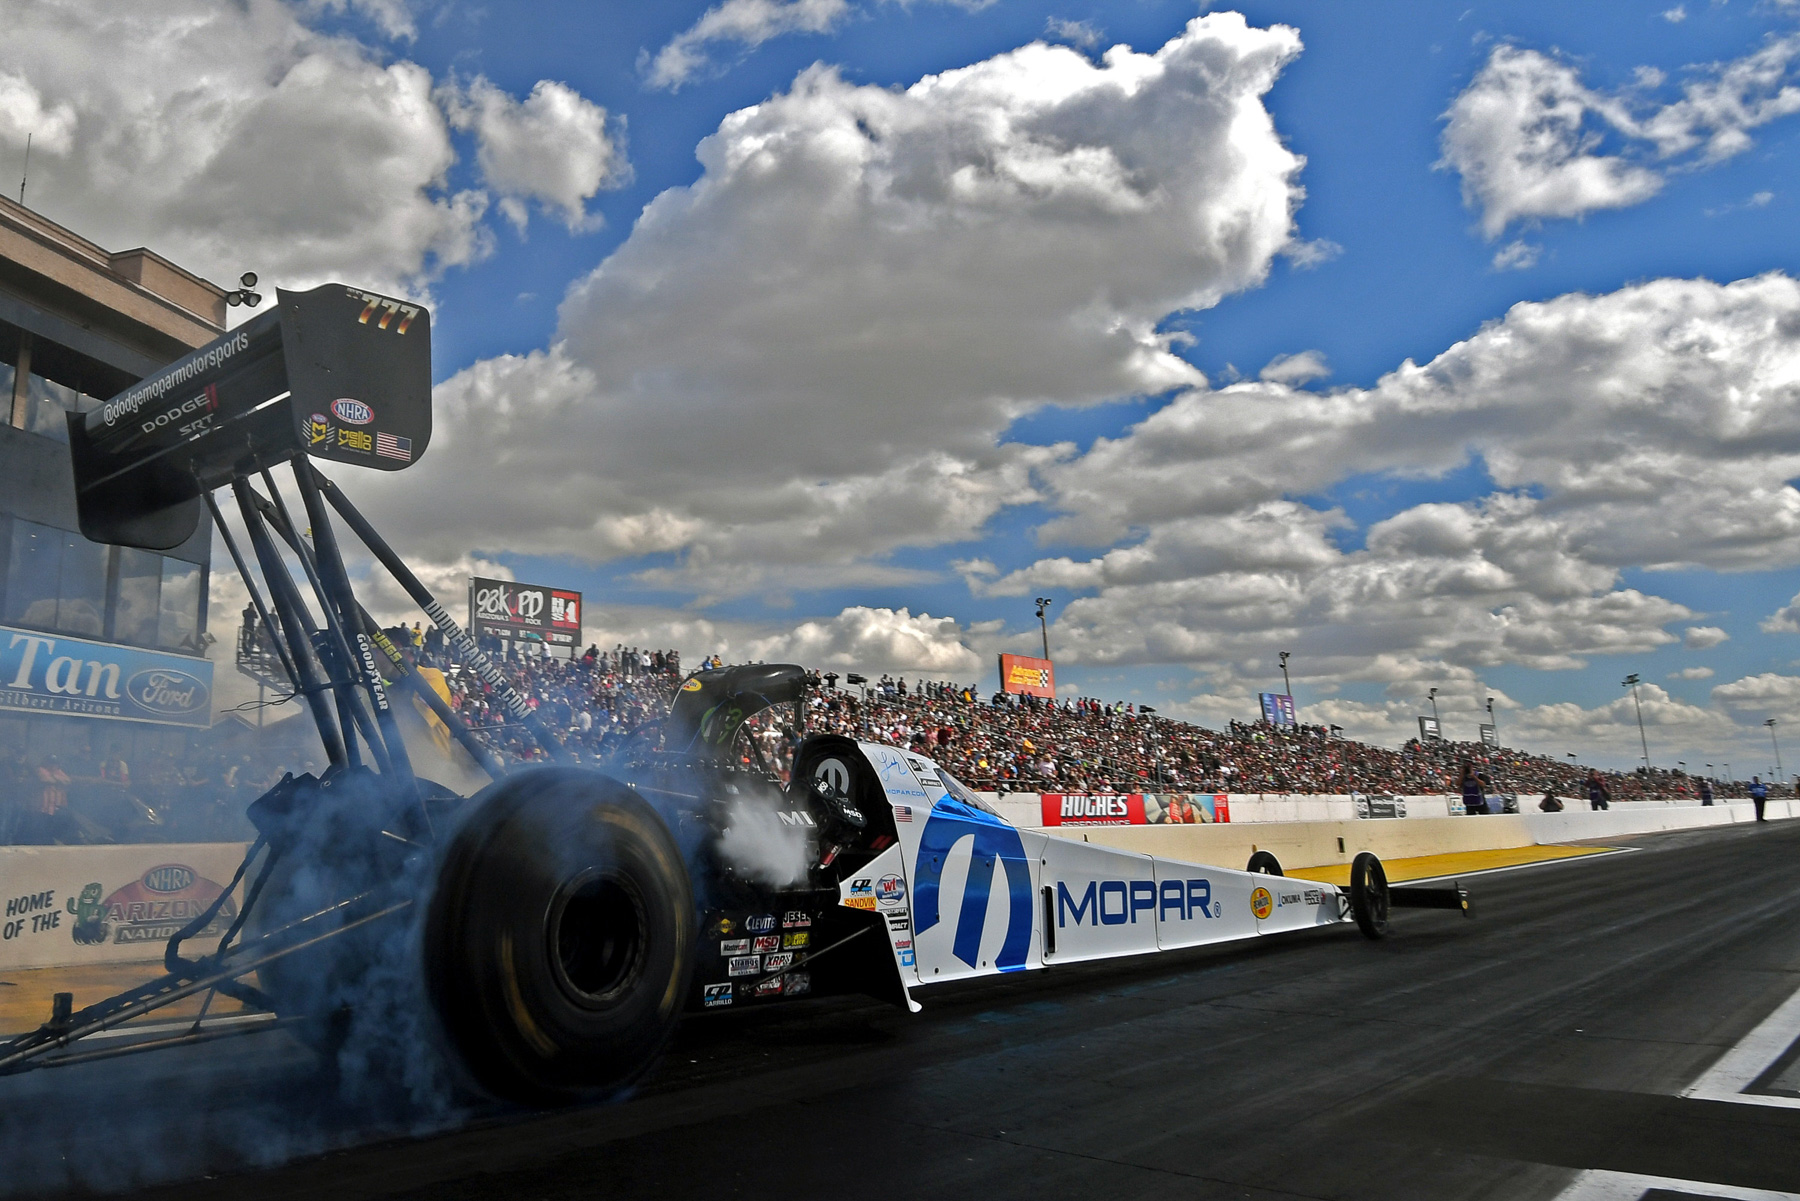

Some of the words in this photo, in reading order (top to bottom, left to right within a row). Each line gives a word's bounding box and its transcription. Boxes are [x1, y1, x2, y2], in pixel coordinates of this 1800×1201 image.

[358, 293, 420, 335] 777
[103, 331, 249, 427] @dodgemoparmotorsports
[141, 393, 211, 434] DODGE
[337, 404, 369, 420] NHRA
[178, 413, 214, 437] SRT
[8, 633, 121, 700] Tan
[356, 633, 389, 711] GOODYEAR
[142, 672, 196, 708] Ford
[62, 700, 121, 715] Arizona
[1060, 795, 1128, 818] HUGHES
[149, 867, 192, 889] NHRA
[6, 890, 56, 917] HOME
[845, 897, 876, 907] SANDVIK
[1057, 878, 1213, 928] MOPAR
[1281, 894, 1302, 905] OKUMA
[3, 919, 26, 940] OF
[31, 910, 62, 933] THE
[745, 914, 775, 930] CLEVITE
[755, 936, 779, 949] MSD
[767, 955, 785, 966] XRP
